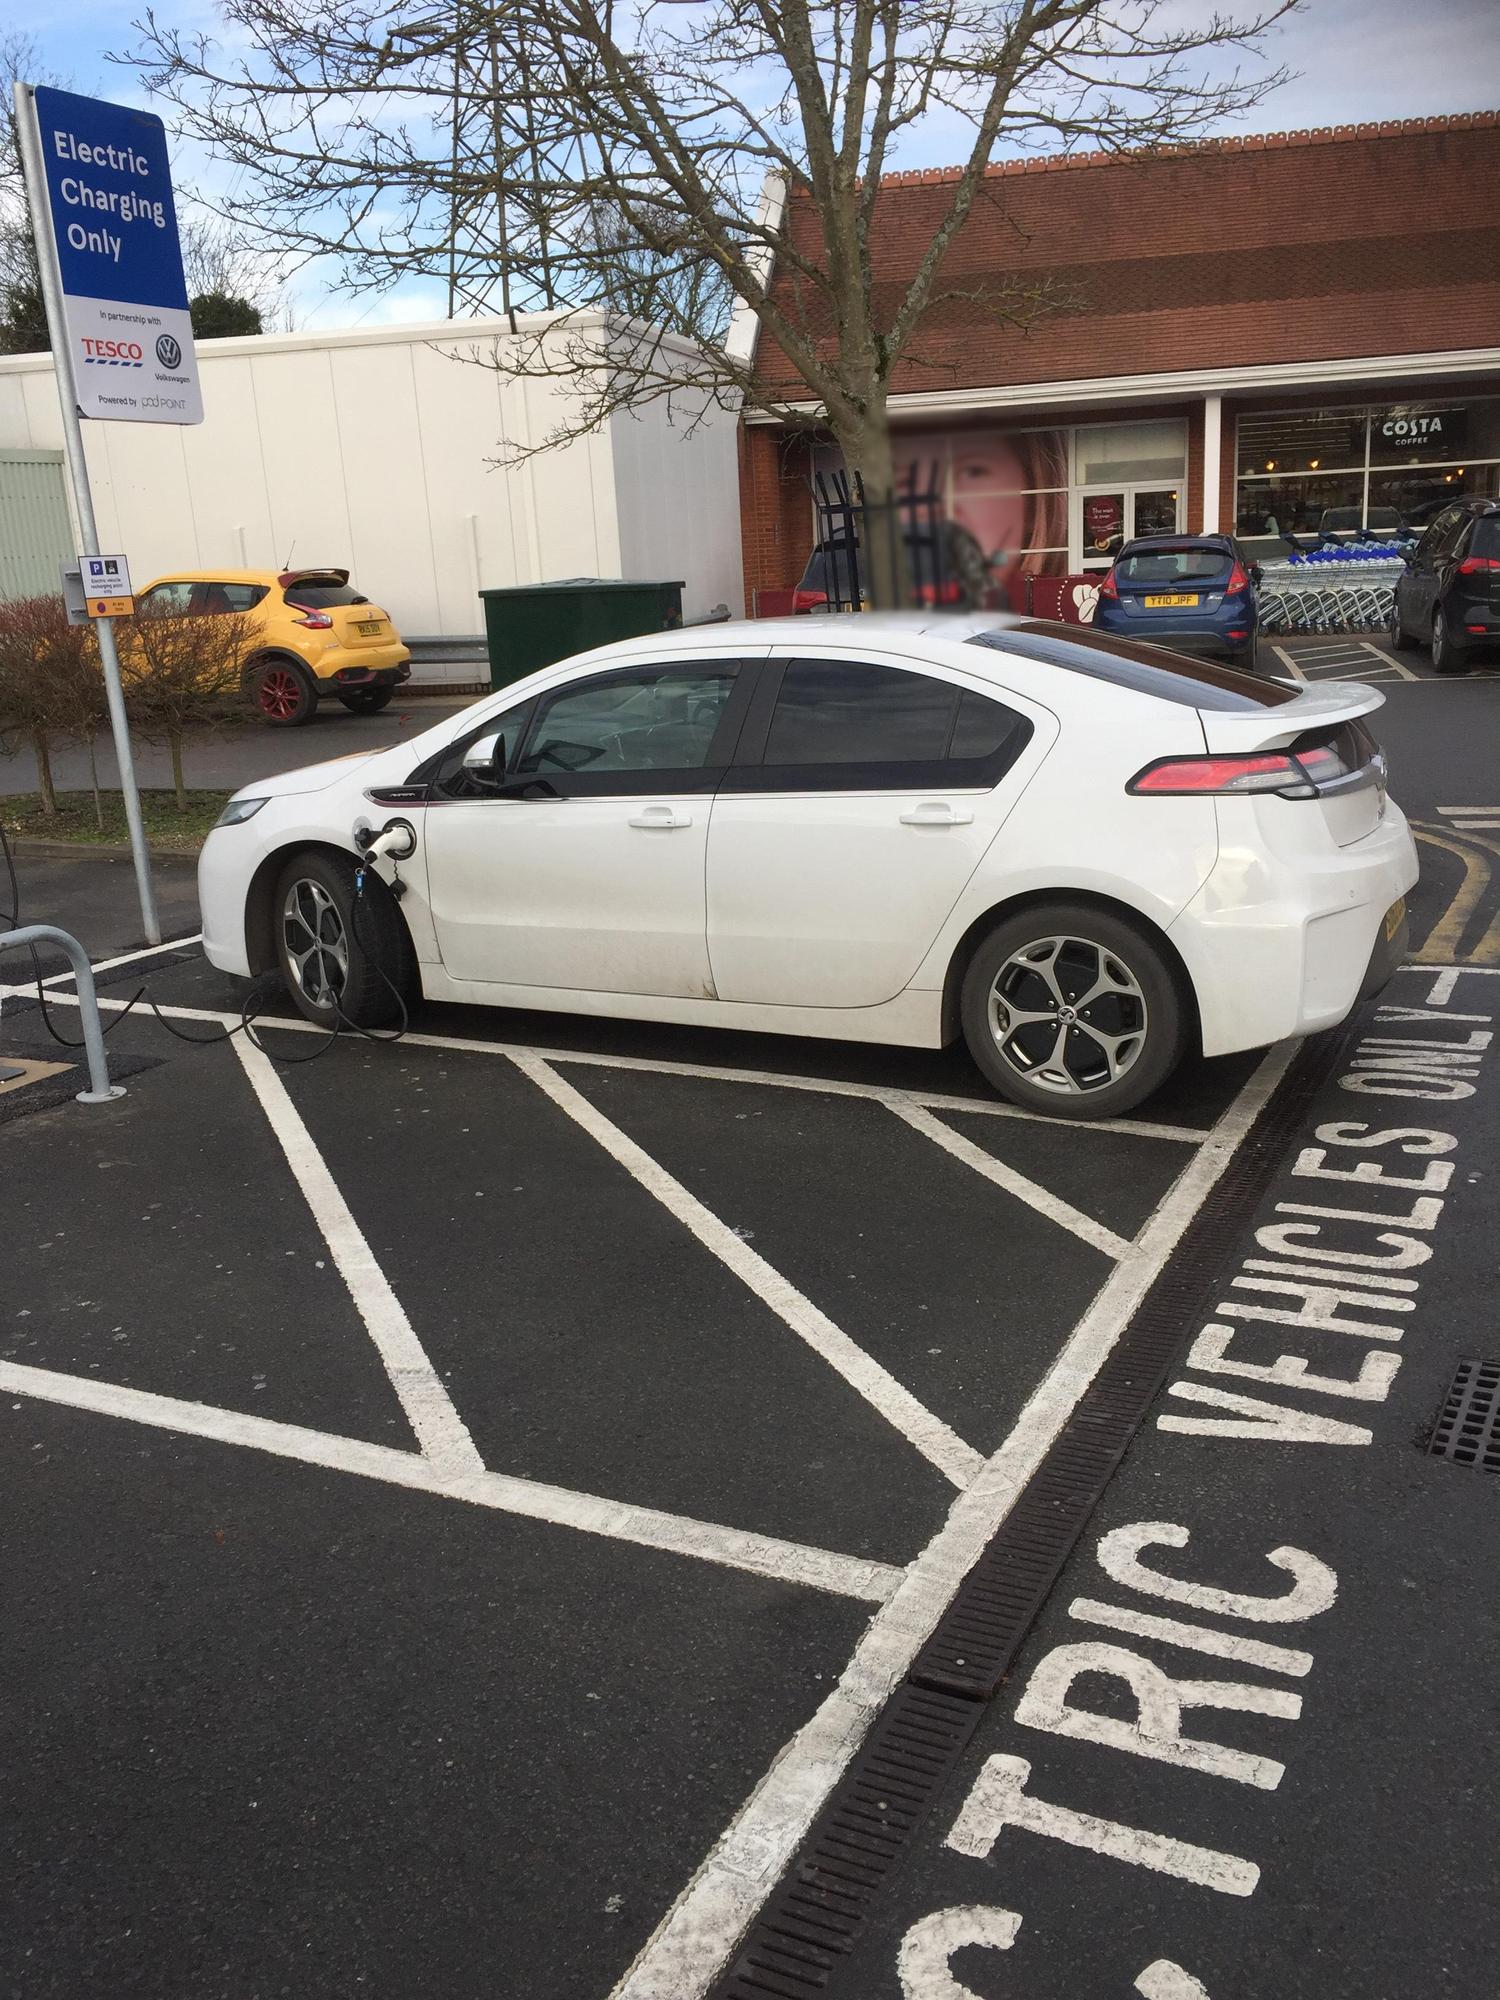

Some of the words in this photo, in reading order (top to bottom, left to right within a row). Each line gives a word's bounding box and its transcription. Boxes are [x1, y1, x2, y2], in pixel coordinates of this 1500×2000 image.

[54, 130, 149, 176] Electric
[61, 177, 166, 228] Charging
[67, 223, 121, 262] Only
[99, 310, 107, 319] In
[108, 312, 146, 325] partnership
[147, 316, 162, 325] with
[81, 338, 143, 360] TESCO
[154, 373, 191, 384] Volkswagen
[98, 395, 128, 406] Powered
[129, 397, 137, 407] by
[1382, 417, 1442, 436] COSTA
[1395, 437, 1428, 446] COFFEE
[1156, 1121, 1459, 1446] VEHICLES
[1337, 1005, 1494, 1101] ONLY
